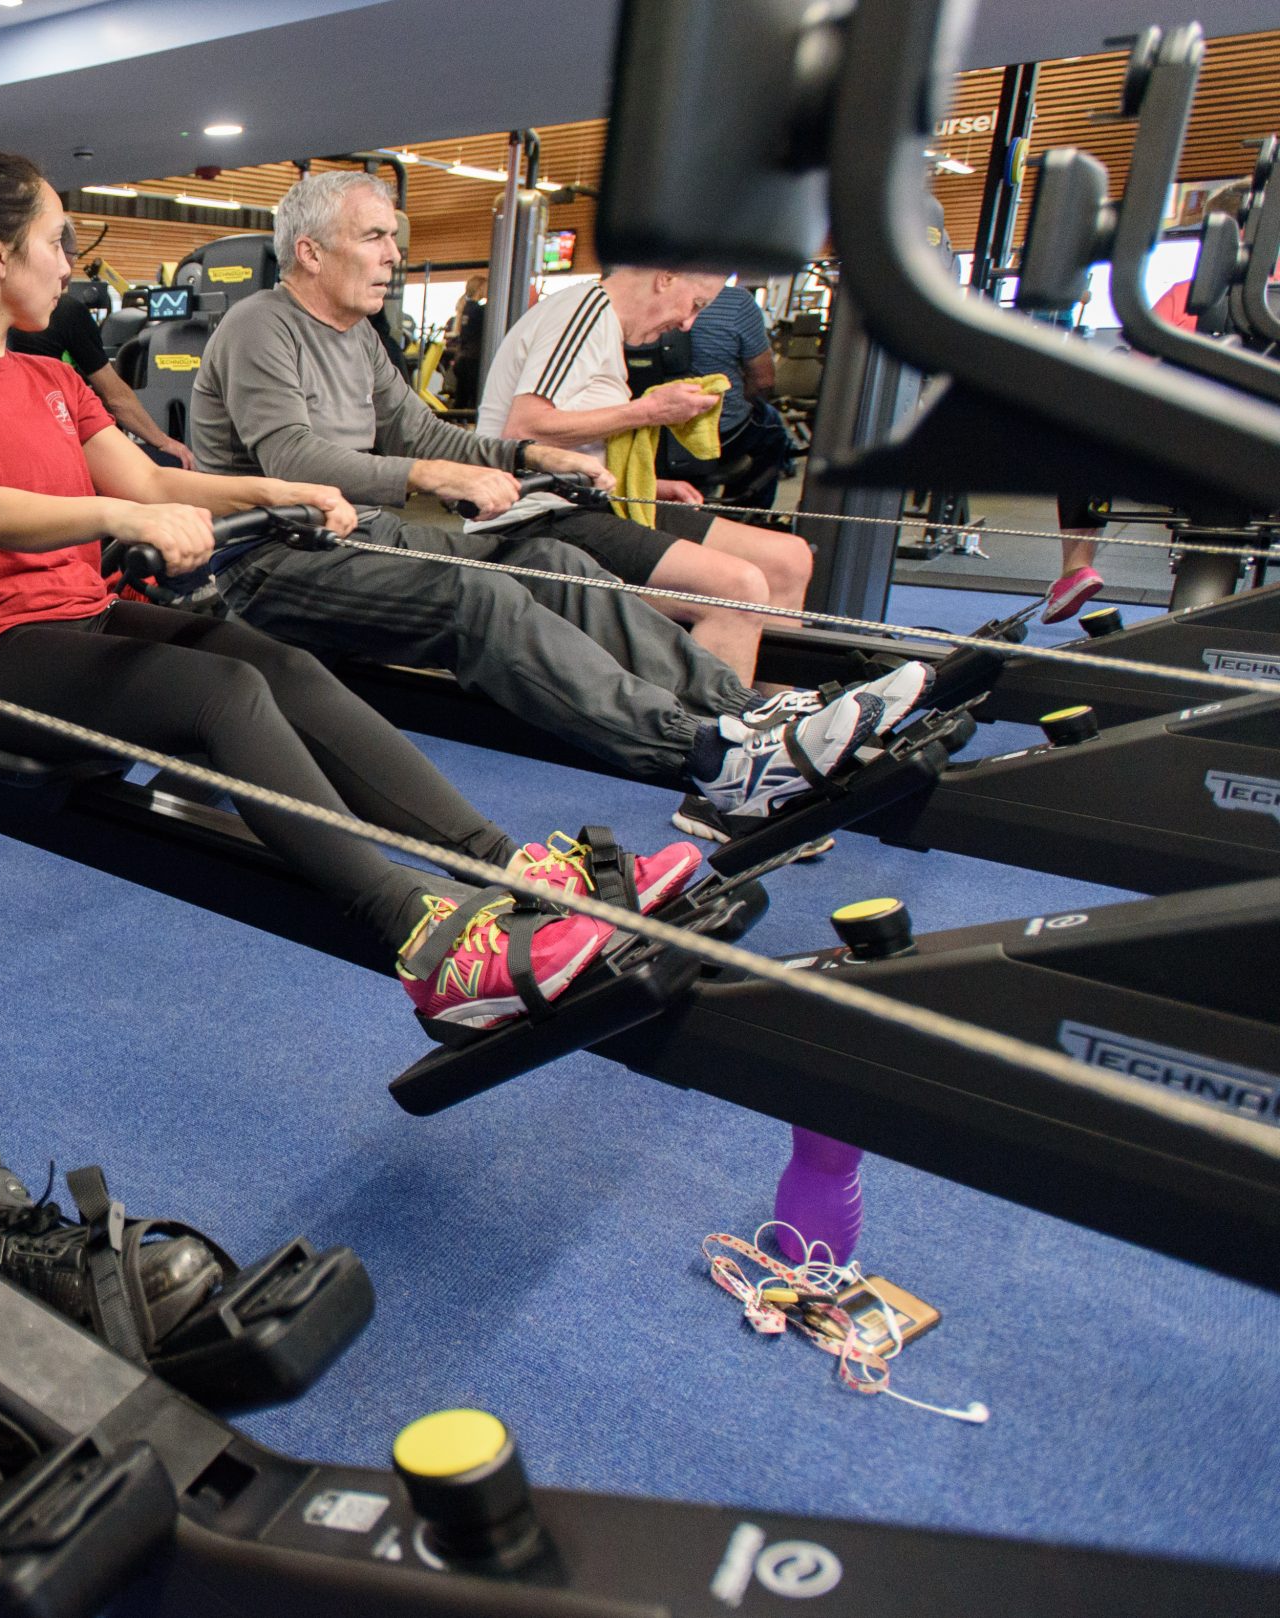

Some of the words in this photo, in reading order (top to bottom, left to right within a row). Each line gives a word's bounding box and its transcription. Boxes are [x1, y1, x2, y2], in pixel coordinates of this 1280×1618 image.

[933, 109, 999, 137] ursel
[436, 957, 484, 998] N
[1067, 1029, 1280, 1119] TECHNO
